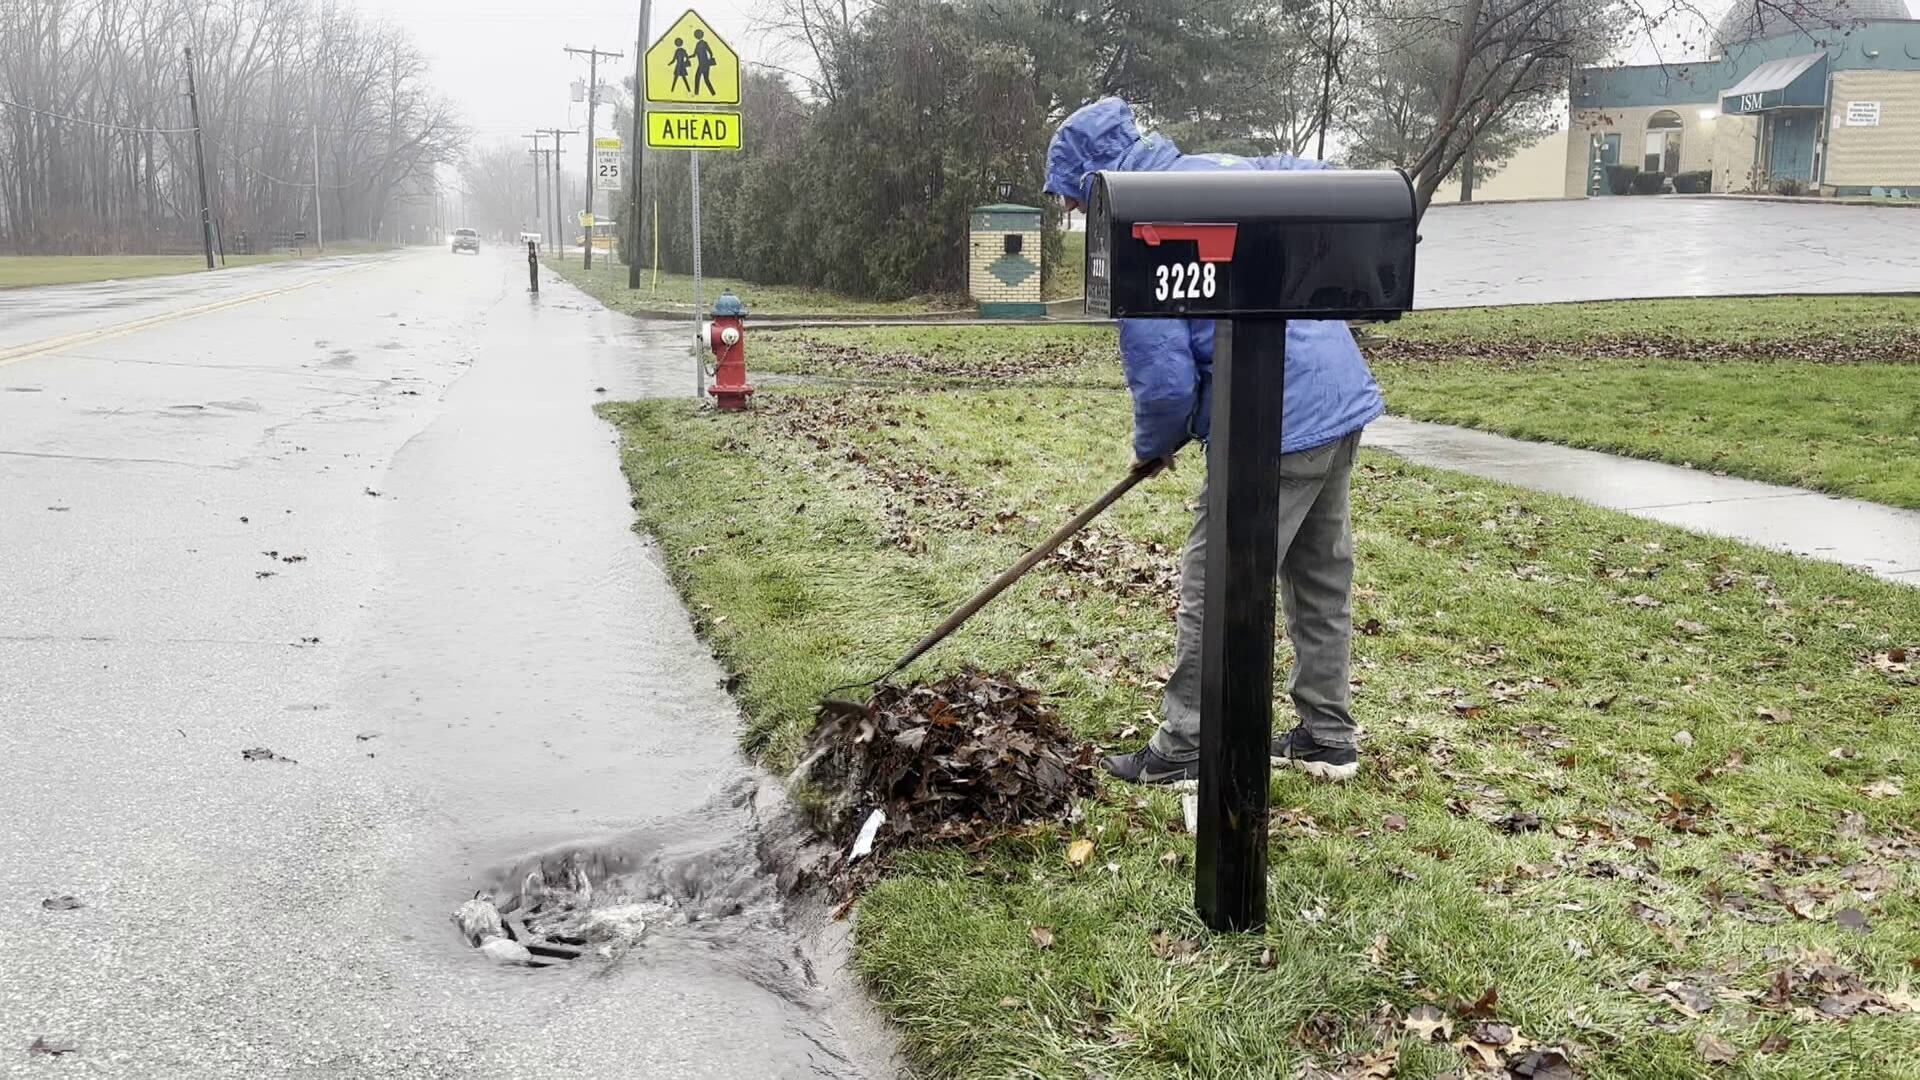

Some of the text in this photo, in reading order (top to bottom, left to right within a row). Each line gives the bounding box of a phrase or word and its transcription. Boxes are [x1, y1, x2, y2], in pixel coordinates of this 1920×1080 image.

[1740, 93, 1763, 112] ISM
[662, 119, 727, 140] AHEAD
[600, 165, 618, 177] 25
[1155, 262, 1216, 301] 3228
